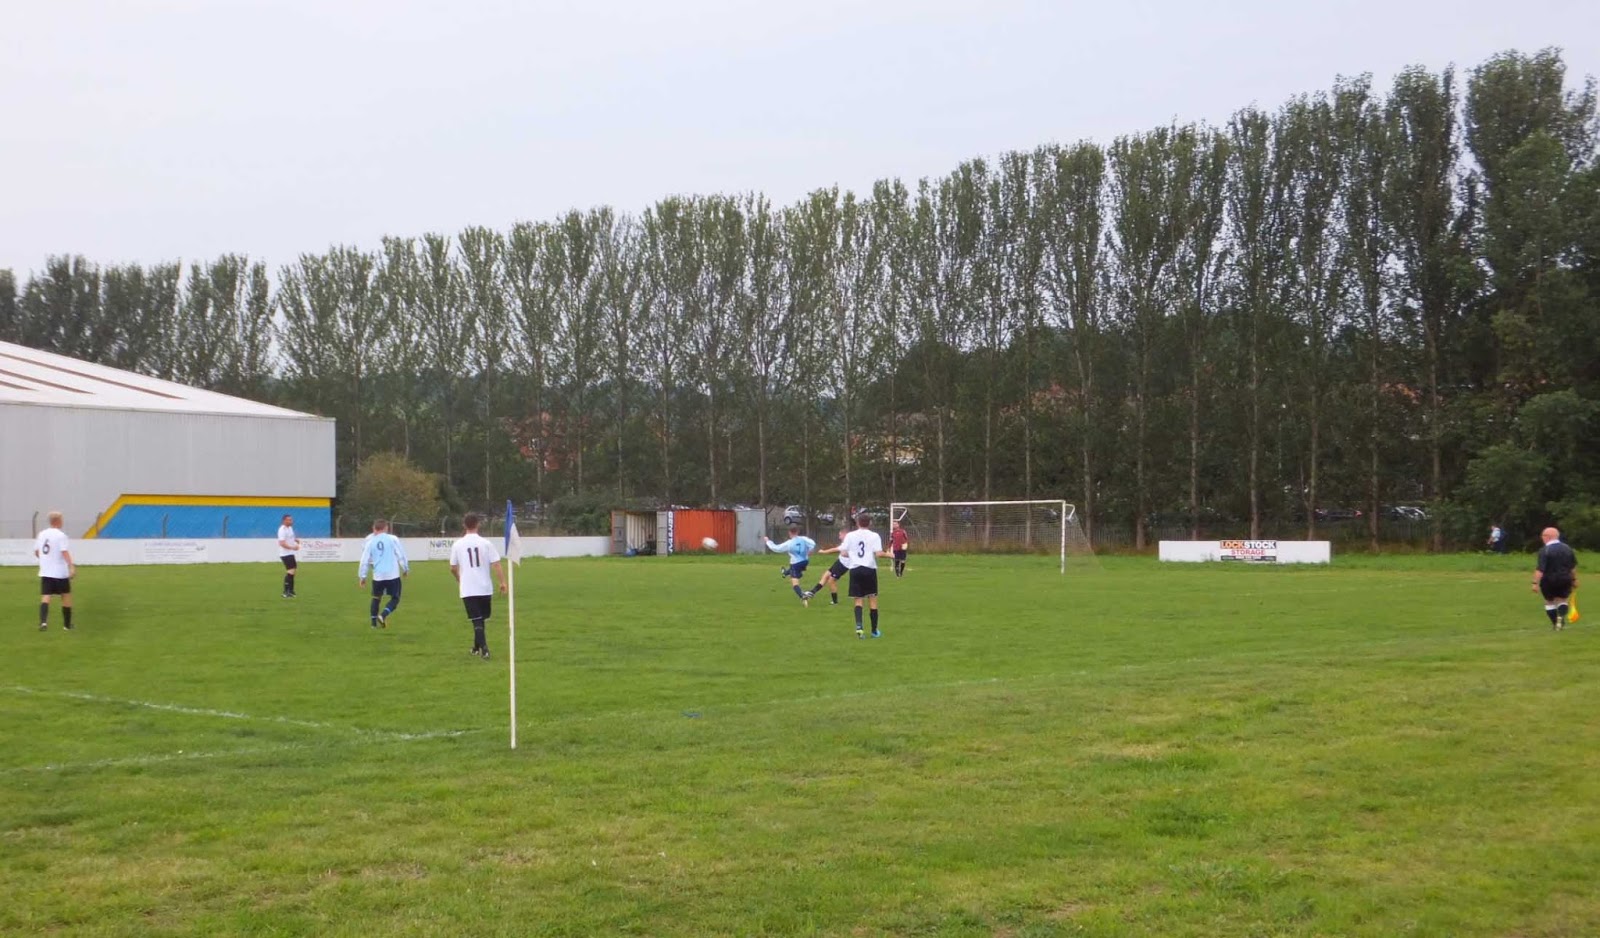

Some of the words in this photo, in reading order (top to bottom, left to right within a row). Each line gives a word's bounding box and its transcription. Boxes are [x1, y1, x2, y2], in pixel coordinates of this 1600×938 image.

[42, 539, 50, 555] 6
[376, 541, 385, 557] 9
[858, 541, 865, 558] 3
[467, 547, 480, 568] 11
